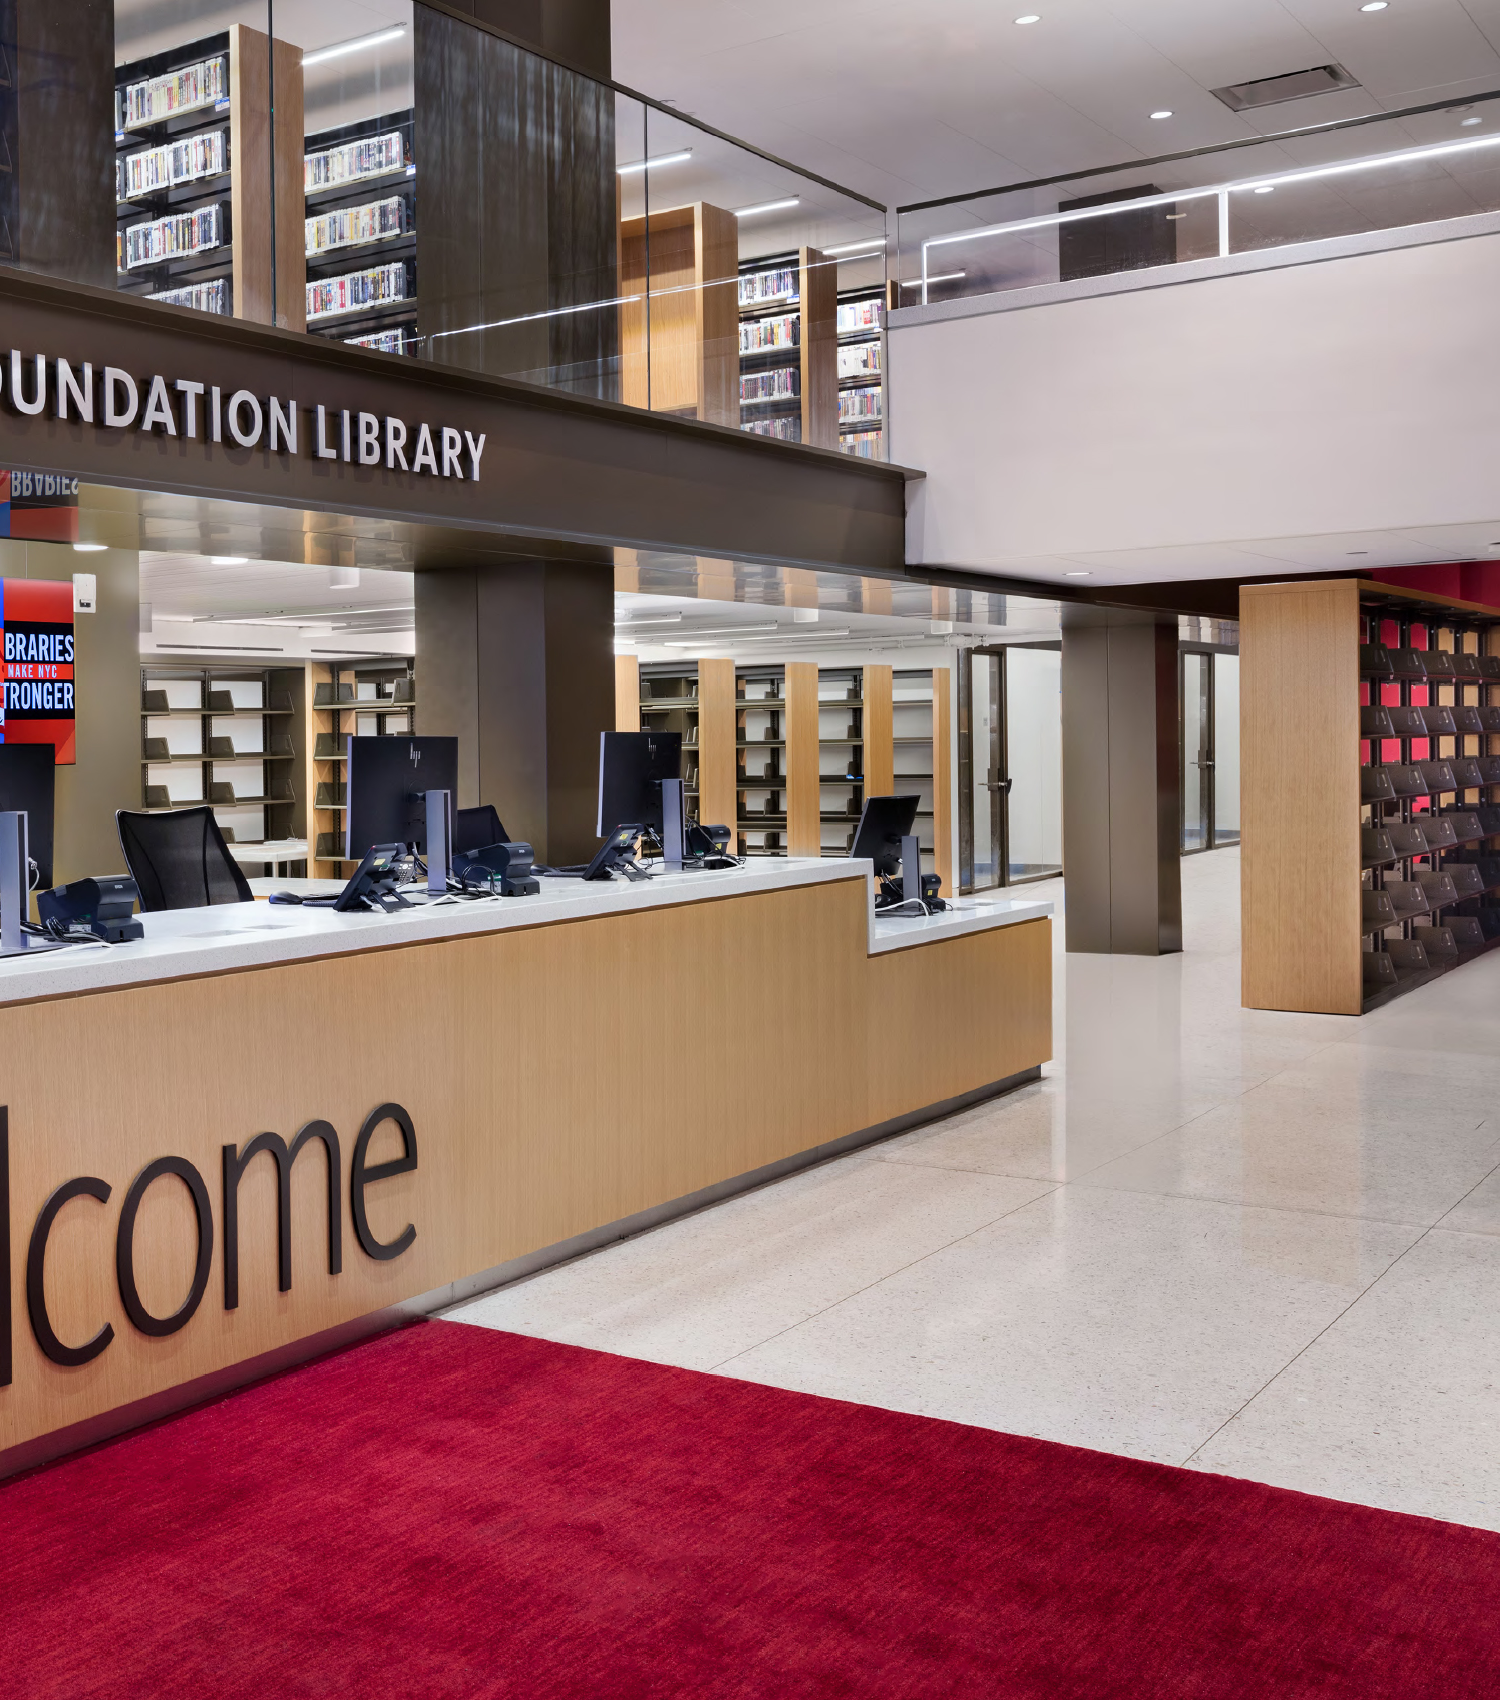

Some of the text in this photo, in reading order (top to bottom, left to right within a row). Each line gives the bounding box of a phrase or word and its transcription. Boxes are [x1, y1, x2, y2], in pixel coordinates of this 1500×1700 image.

[315, 404, 487, 482] LIBRARY
[4, 633, 74, 662] BRARIES
[8, 664, 58, 678] MAKE NYC
[4, 682, 74, 710] TRONGER
[410, 742, 421, 768] hp
